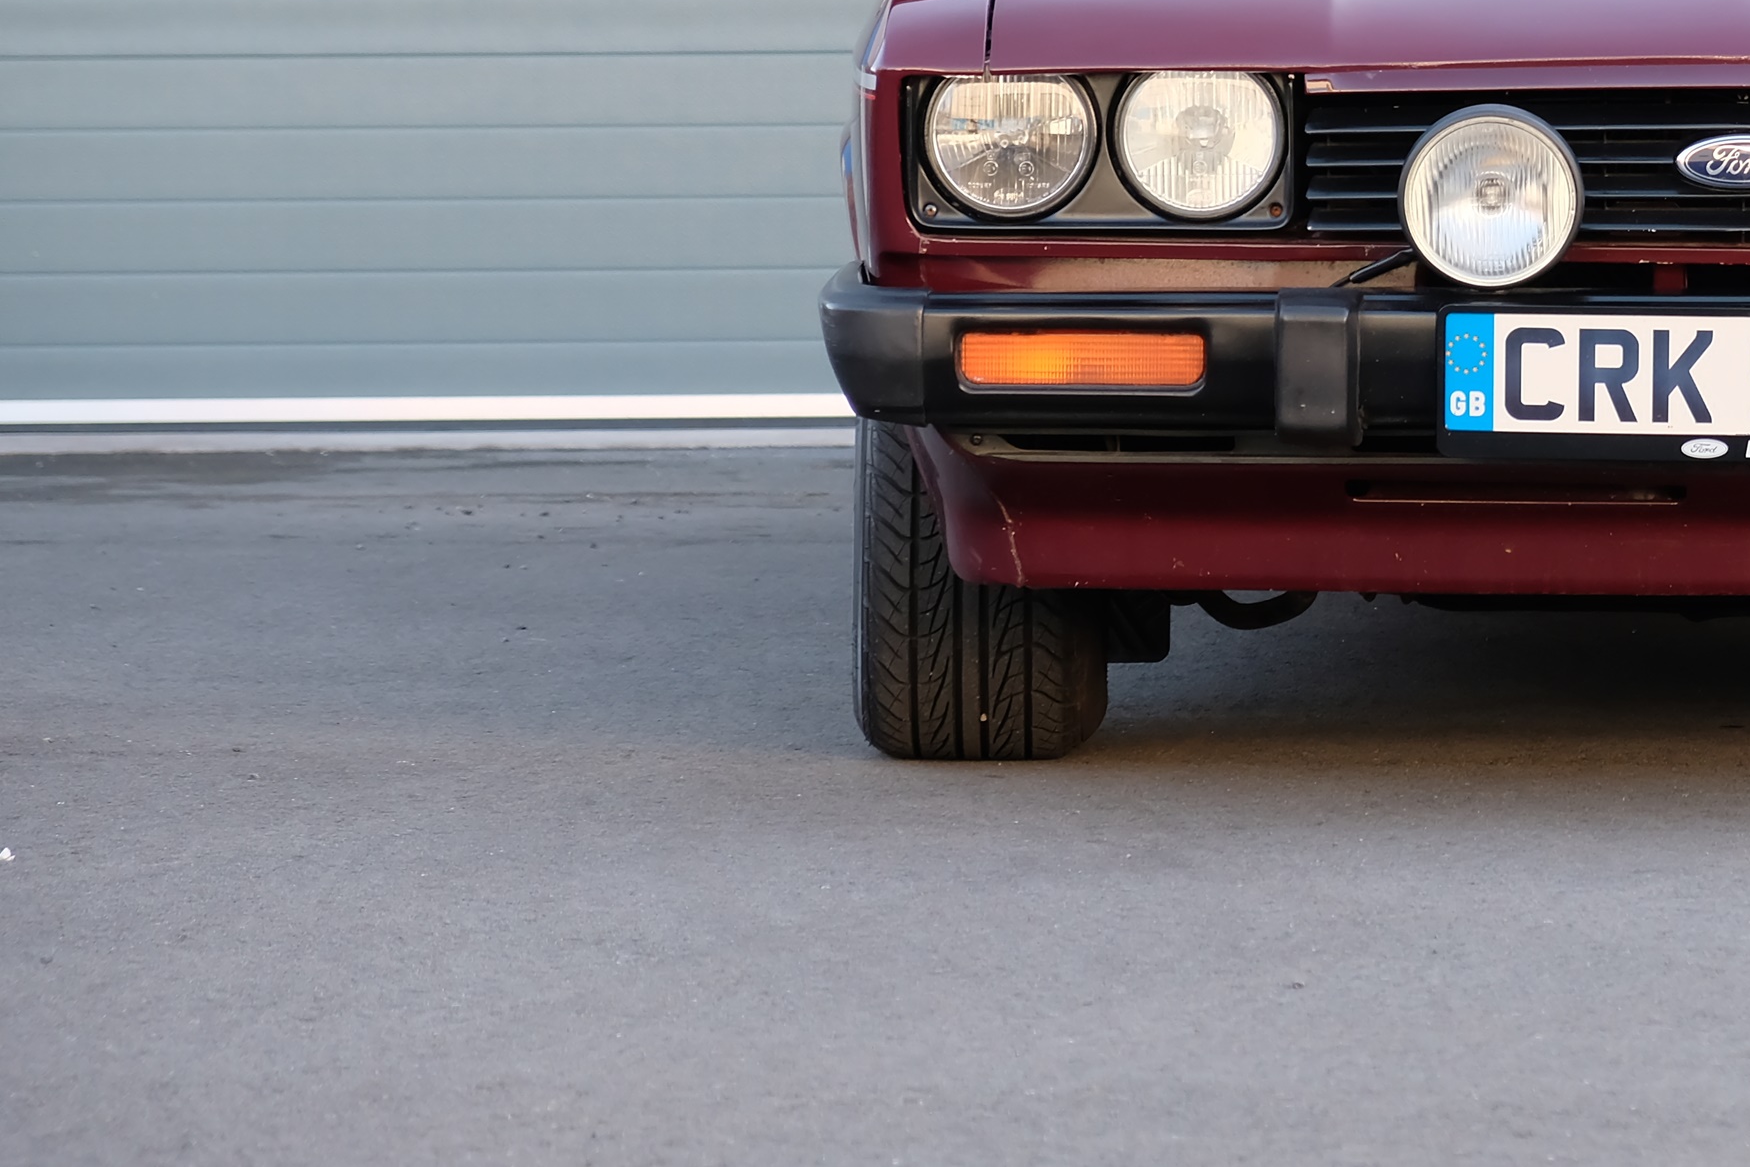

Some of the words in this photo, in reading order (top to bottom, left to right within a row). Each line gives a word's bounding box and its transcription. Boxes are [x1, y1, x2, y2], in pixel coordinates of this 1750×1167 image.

[1504, 326, 1715, 424] CRK
[1450, 390, 1486, 417] GB
[1689, 442, 1718, 454] Ford
